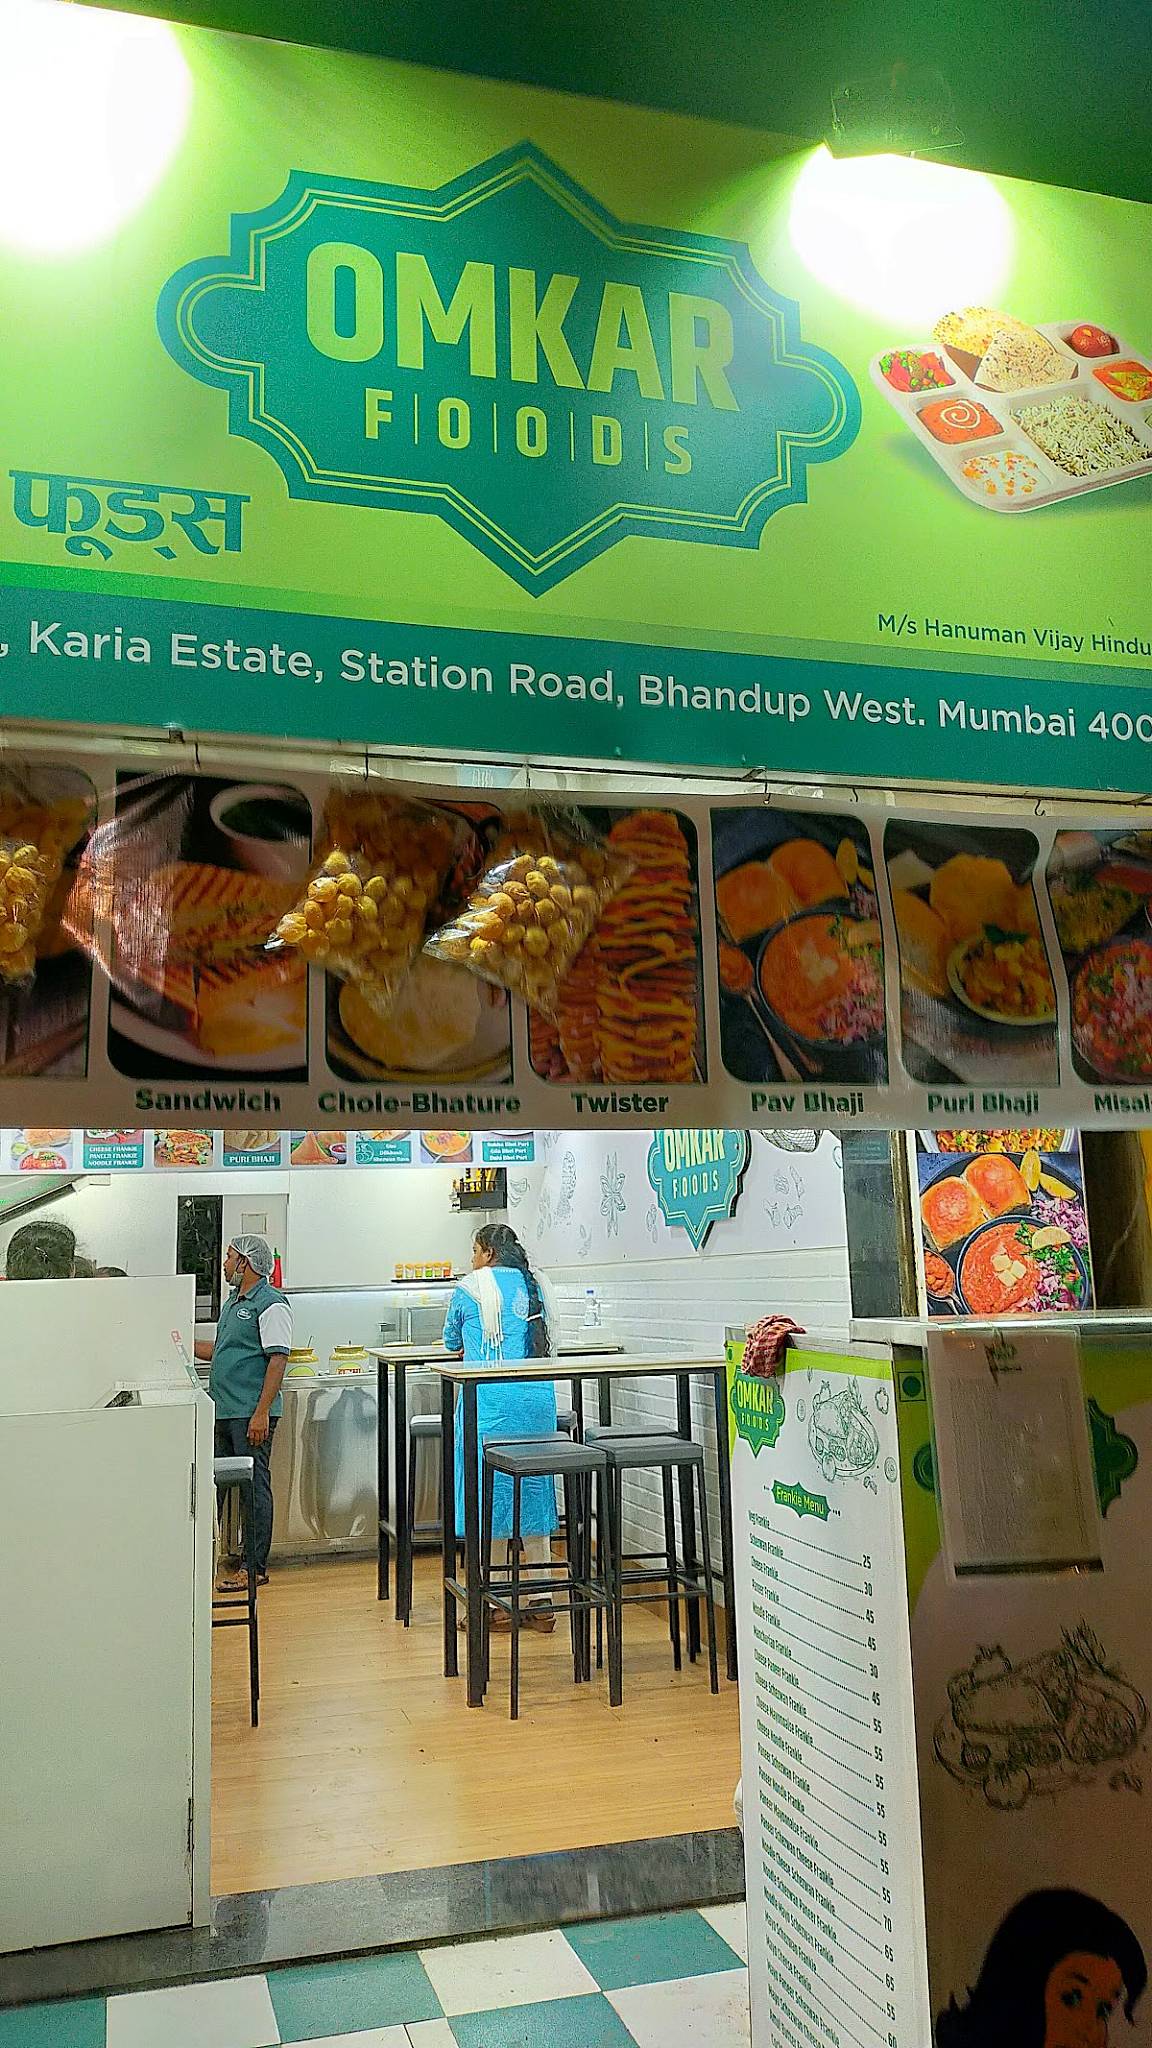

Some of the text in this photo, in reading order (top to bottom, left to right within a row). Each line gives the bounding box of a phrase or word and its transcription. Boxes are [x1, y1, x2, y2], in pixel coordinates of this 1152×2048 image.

[307, 242, 740, 411] OMKAR
[9, 470, 250, 561] फूड्स
[878, 614, 1152, 656] M/s Hanuman Vijay Hindu
[29, 620, 1152, 743] Karia Estate, Station Road, Bhandup West. Mumbai 400
[135, 1088, 281, 1112] Sandwich
[318, 1090, 520, 1113] Chole-Bhature
[570, 1091, 669, 1113] Twister
[751, 1091, 864, 1117] Pav Bhaji
[928, 1091, 1039, 1117] Puri Bhaji
[1094, 1090, 1152, 1114] Misal
[664, 1129, 725, 1173] OMKAR
[673, 1170, 719, 1199] FOODS
[737, 1380, 774, 1415] OMKAR
[742, 1412, 769, 1431] FOODS
[776, 1486, 824, 1515] Frankie Menu
[863, 1554, 871, 1569] 25
[864, 1581, 873, 1596] 30
[866, 1609, 875, 1624] 45
[868, 1637, 876, 1651] 45
[869, 1663, 878, 1679] 30
[872, 1692, 881, 1706] 45
[873, 1719, 882, 1734] 55
[874, 1747, 883, 1762] 55
[875, 1775, 884, 1790] 55
[877, 1802, 886, 1818] 55
[878, 1831, 887, 1847] 55
[880, 1859, 889, 1875] 55
[882, 1888, 891, 1904] 55
[883, 1915, 892, 1933] 70
[884, 1945, 894, 1962] 65
[885, 1974, 895, 1991] 65
[886, 2003, 896, 2021] 55
